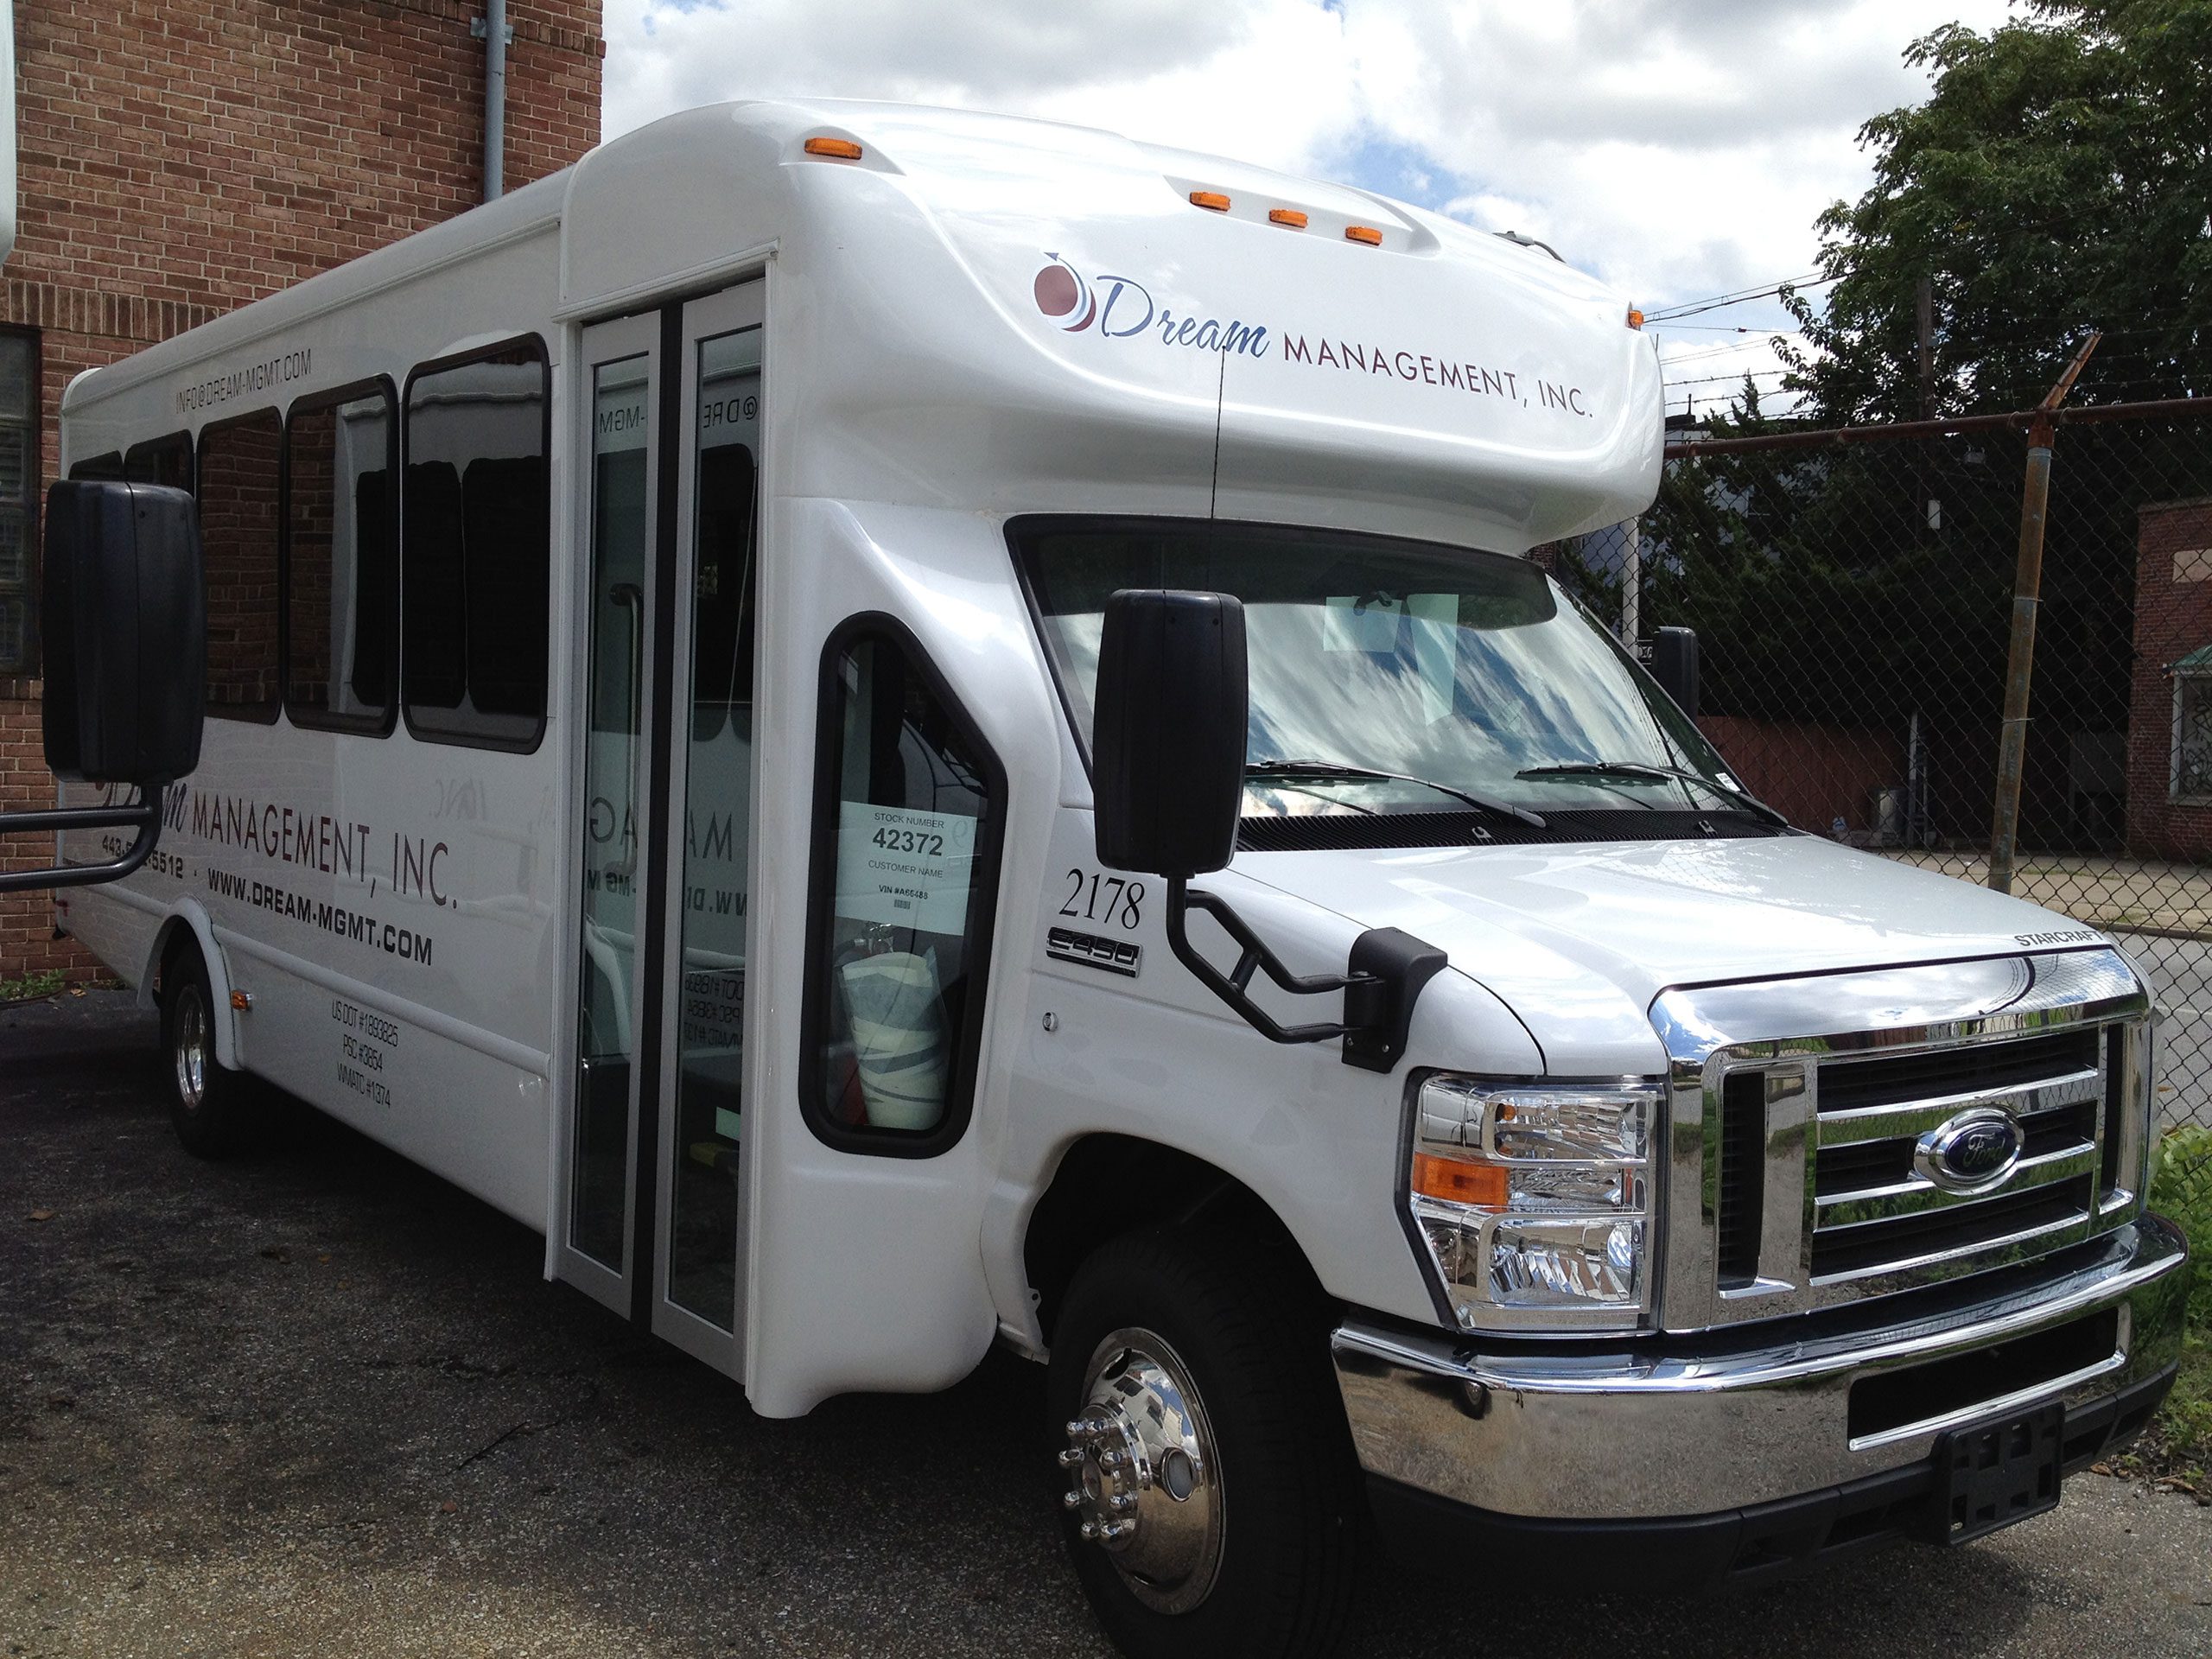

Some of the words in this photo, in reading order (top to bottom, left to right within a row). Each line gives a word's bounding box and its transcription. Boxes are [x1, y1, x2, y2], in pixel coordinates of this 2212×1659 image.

[1096, 275, 1270, 359] Dream
[1284, 332, 1528, 409] MANAGEMENT,
[1538, 379, 1593, 418] INC.
[175, 348, 311, 415] INFO@DREAM-MGMT.COM
[874, 812, 904, 823] STOCK
[906, 817, 944, 829] NUMBER
[193, 790, 376, 899] MANAGEMENT,
[393, 832, 457, 909] INC.
[872, 827, 944, 856] 42372
[868, 860, 917, 874] CUSTOMER
[918, 867, 943, 879] NAME
[879, 884, 893, 894] VIN
[1058, 868, 1145, 930] 2178
[2014, 931, 2103, 947] STARCRAFT
[332, 1000, 342, 1021] US
[343, 1004, 358, 1027] DOT
[343, 1033, 357, 1059] PSC
[337, 1061, 365, 1095] WMATC
[1962, 1132, 2005, 1167] Ford
